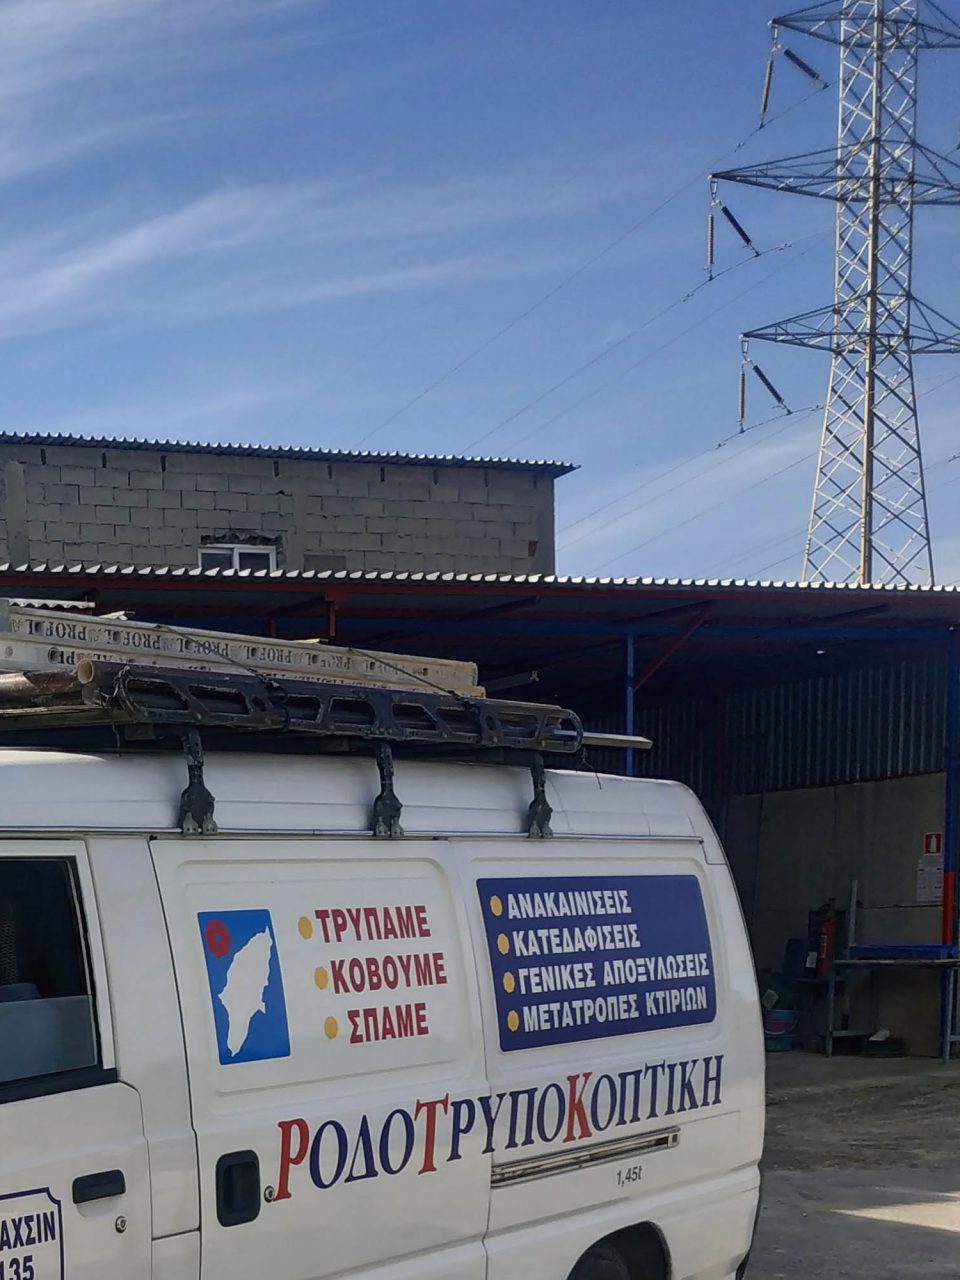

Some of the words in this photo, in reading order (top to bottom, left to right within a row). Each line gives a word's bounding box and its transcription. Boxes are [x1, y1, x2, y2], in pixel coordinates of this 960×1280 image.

[315, 904, 431, 943] ΤΡΥΠΑΜΕ
[506, 890, 633, 920] ΑΝΑΚΑΙΝΙΣΕΙΣ
[512, 923, 641, 956] ΚΑΤΕΔΑΦΙΣΕΙΣ
[330, 951, 448, 994] ΚΟΒΟΥΜΕ
[518, 964, 597, 995] ΓΕΝΙΚΕΣ
[602, 953, 710, 984] ΑΠΟΞΥΛΩΣΕΙΣ
[347, 1002, 430, 1044] ΣΠΑΜΕ
[522, 993, 640, 1033] ΜΕΤΑΤΡΟΠΕΣ
[645, 986, 708, 1017] ΚΤΙΡΙΩΝ
[273, 1055, 725, 1202] ΡΟΔΟΤΡΥΠΟΚΟΠΤΙΚΗ
